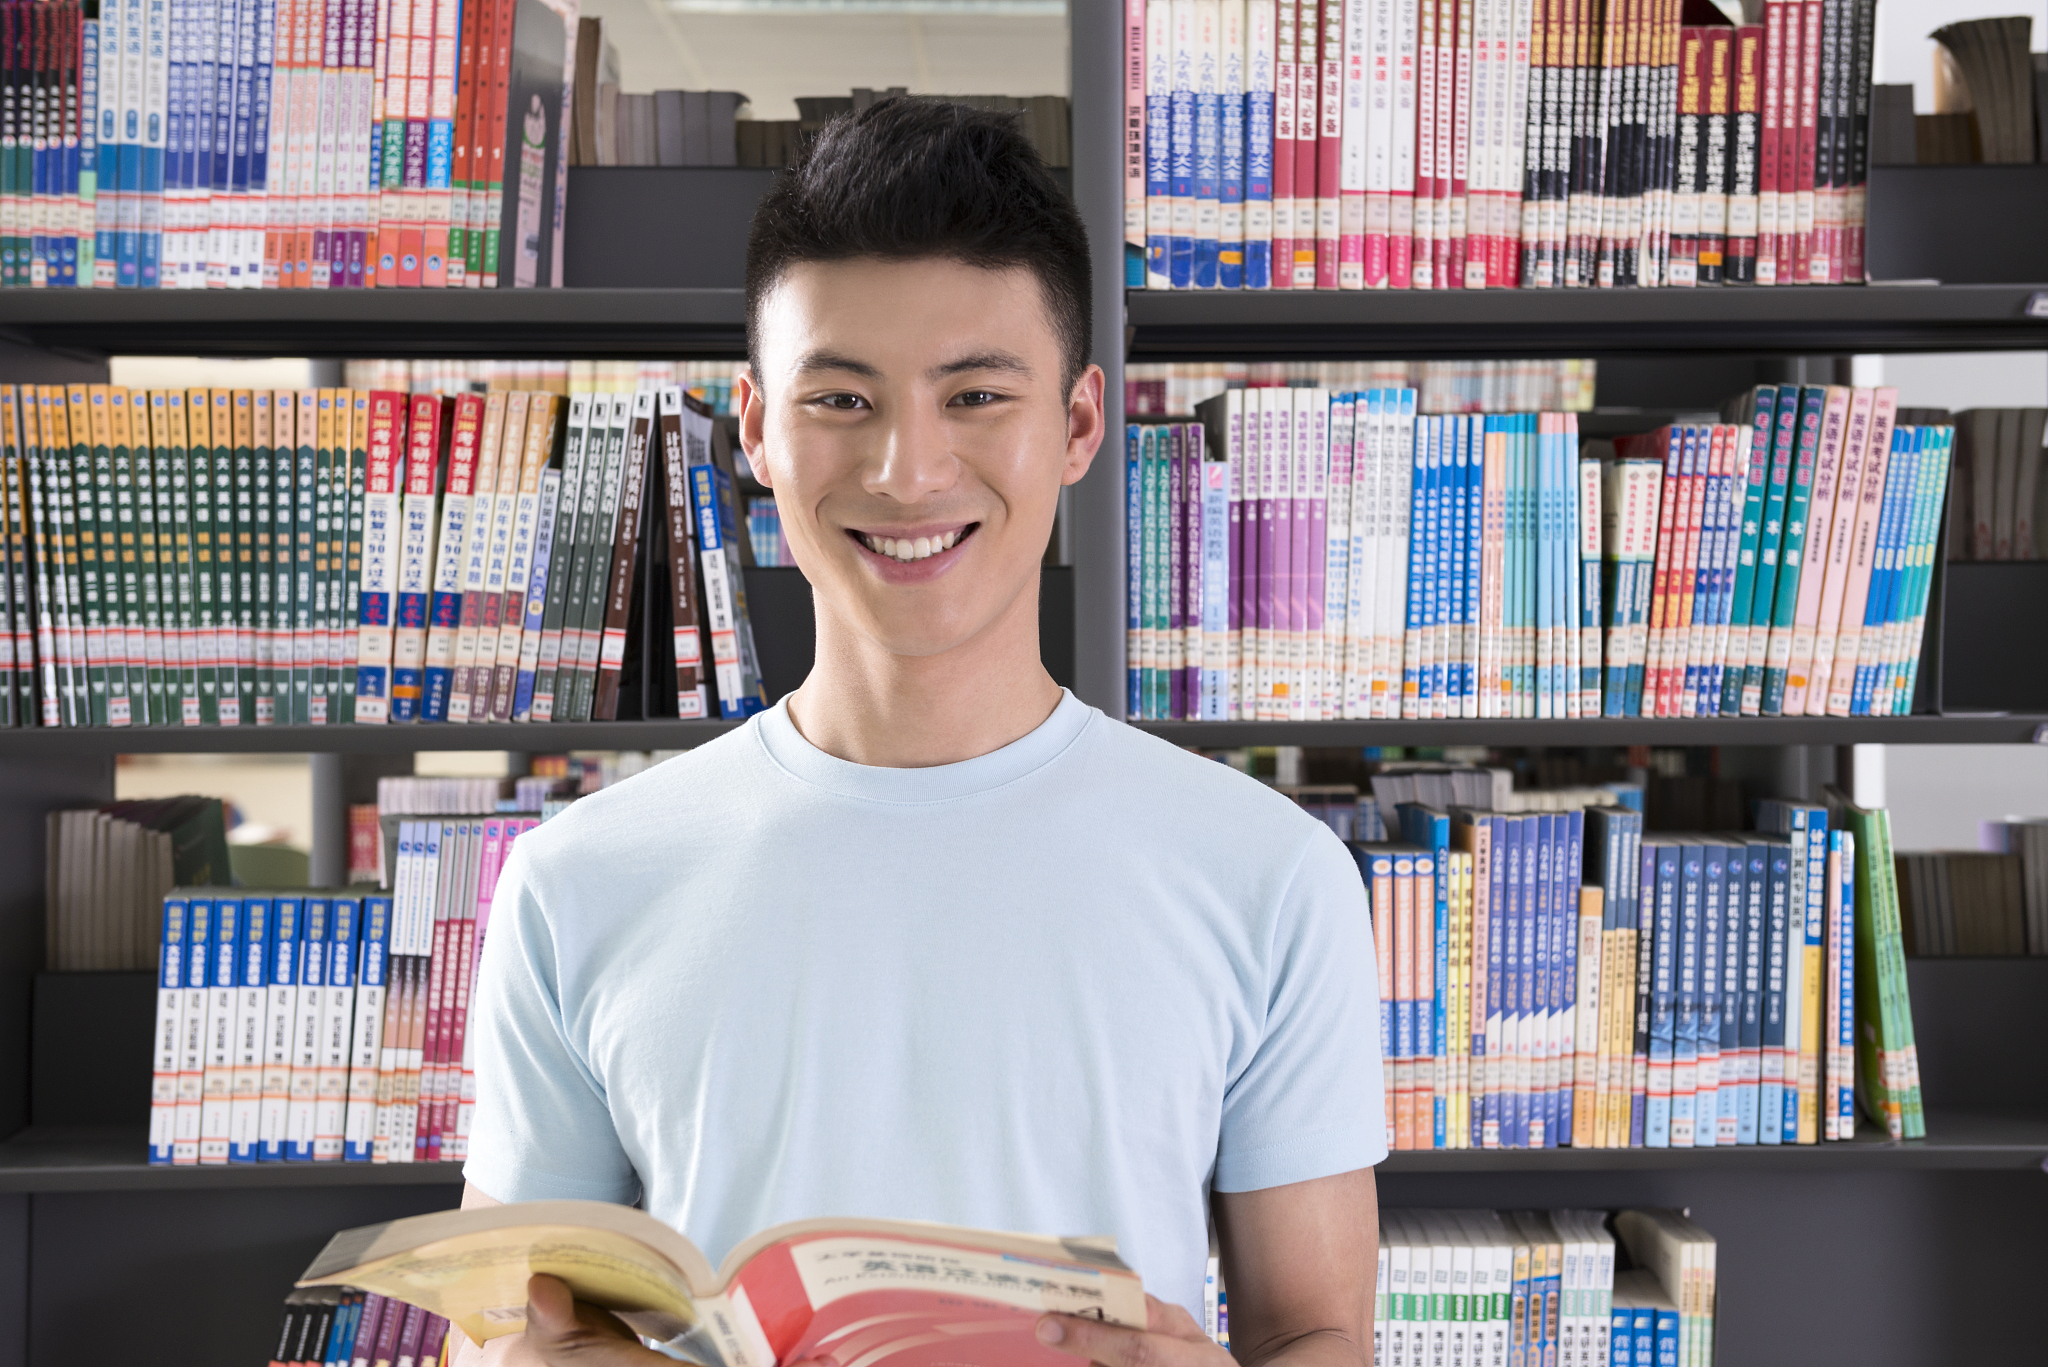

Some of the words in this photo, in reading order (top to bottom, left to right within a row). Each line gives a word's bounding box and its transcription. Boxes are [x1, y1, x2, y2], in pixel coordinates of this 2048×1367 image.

[370, 429, 392, 492] 考研英语
[410, 431, 432, 494] 考研英语
[451, 431, 475, 494] 考研英语
[561, 436, 580, 514] 计算机英语
[581, 437, 602, 515] 计算机英语
[601, 436, 622, 515] 计算机英语
[624, 433, 645, 510] 计算机英语
[666, 431, 684, 507] 计算机英语
[1749, 411, 1770, 486] 考研英语
[1772, 411, 1794, 486] 考研英语
[1796, 411, 1819, 487] 考研英语
[468, 498, 488, 585] 历年考研真题
[489, 499, 510, 586] 历年考研真题
[511, 498, 533, 586] 历年考研真题
[1740, 495, 1761, 567] 一本通
[1763, 495, 1783, 566] 一本通
[1786, 495, 1807, 567] 一本通
